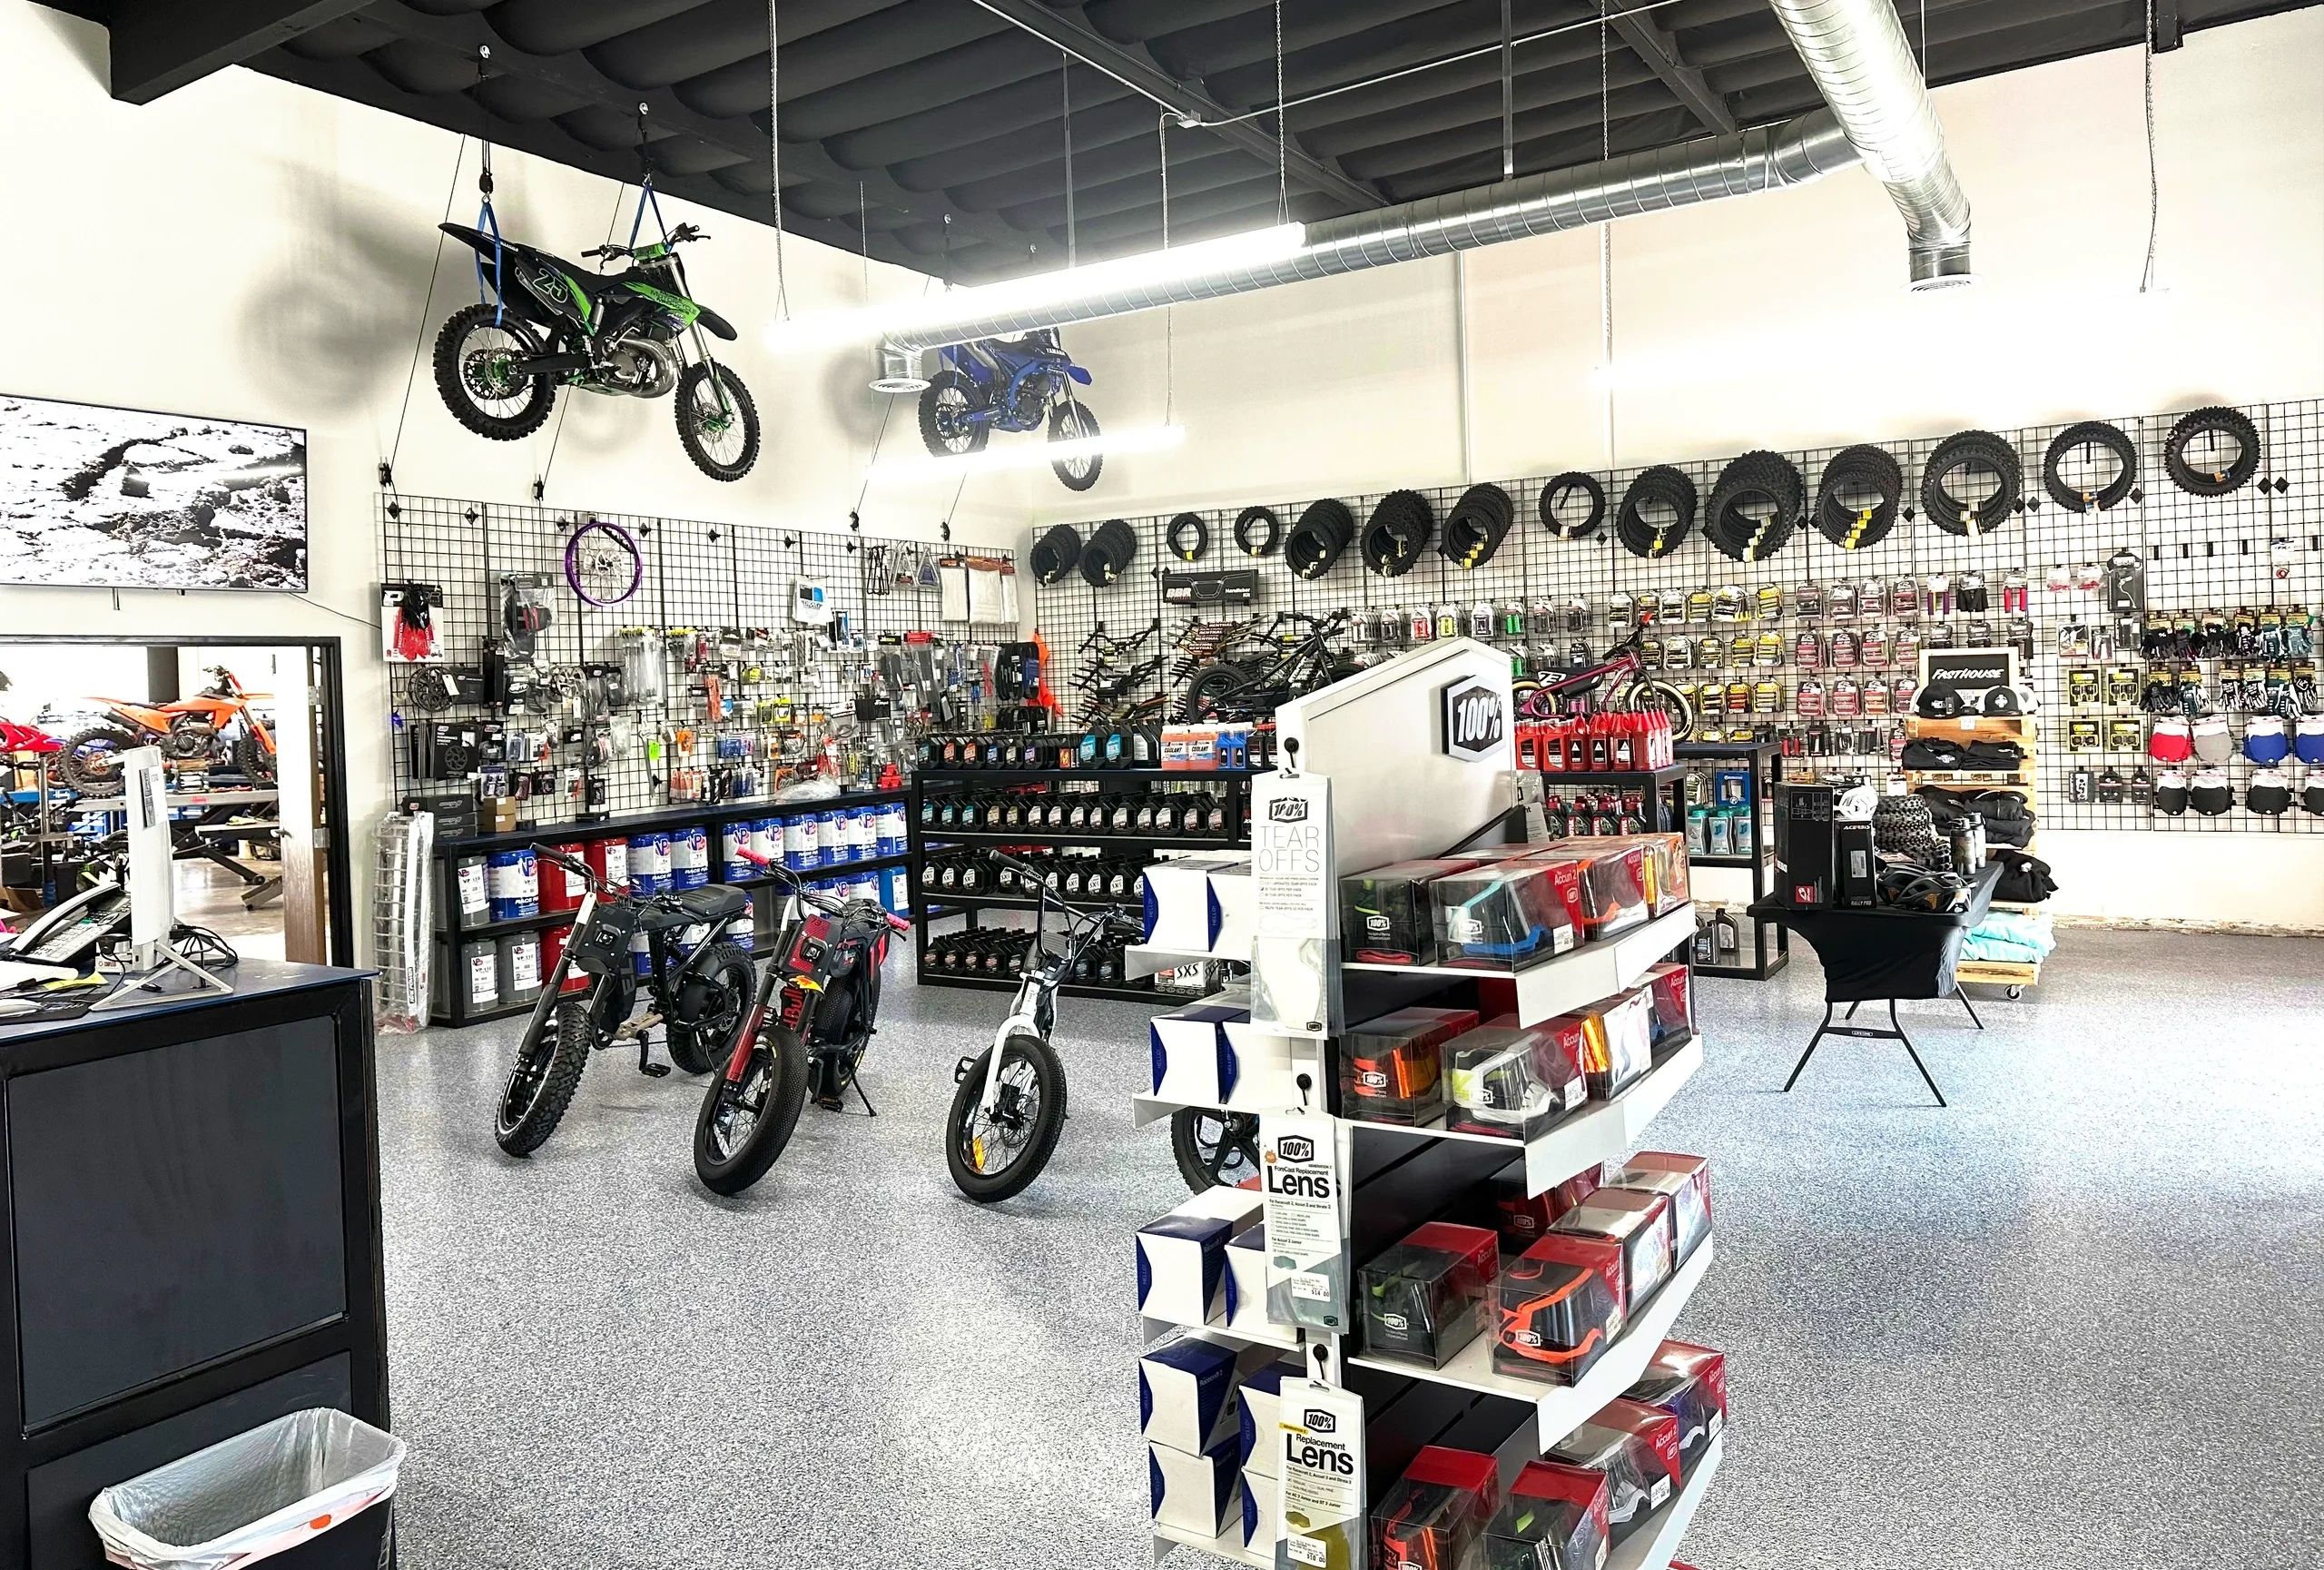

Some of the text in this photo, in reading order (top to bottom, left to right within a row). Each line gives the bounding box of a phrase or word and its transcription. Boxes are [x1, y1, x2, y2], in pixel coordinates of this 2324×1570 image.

[1932, 668, 2004, 680] FASTHOUSE
[1457, 696, 1502, 743] 100%
[1259, 826, 1319, 848] TEAR
[1259, 849, 1319, 872] OFFS
[1554, 874, 1572, 885] Accuri
[1369, 919, 1387, 928] 100%
[1177, 963, 1199, 980] SXS
[784, 987, 803, 1019] Bull
[1366, 1075, 1384, 1084] 100%
[1282, 1141, 1310, 1157] 100%
[1295, 1168, 1328, 1176] Replacement
[1267, 1166, 1330, 1199] Lens
[1386, 1317, 1405, 1327] 100%
[1518, 1332, 1539, 1343] 100%
[1308, 1414, 1332, 1428] 100%
[1296, 1434, 1345, 1451] Replacement
[1655, 1431, 1672, 1450] Accuri
[1286, 1433, 1354, 1475] Lens
